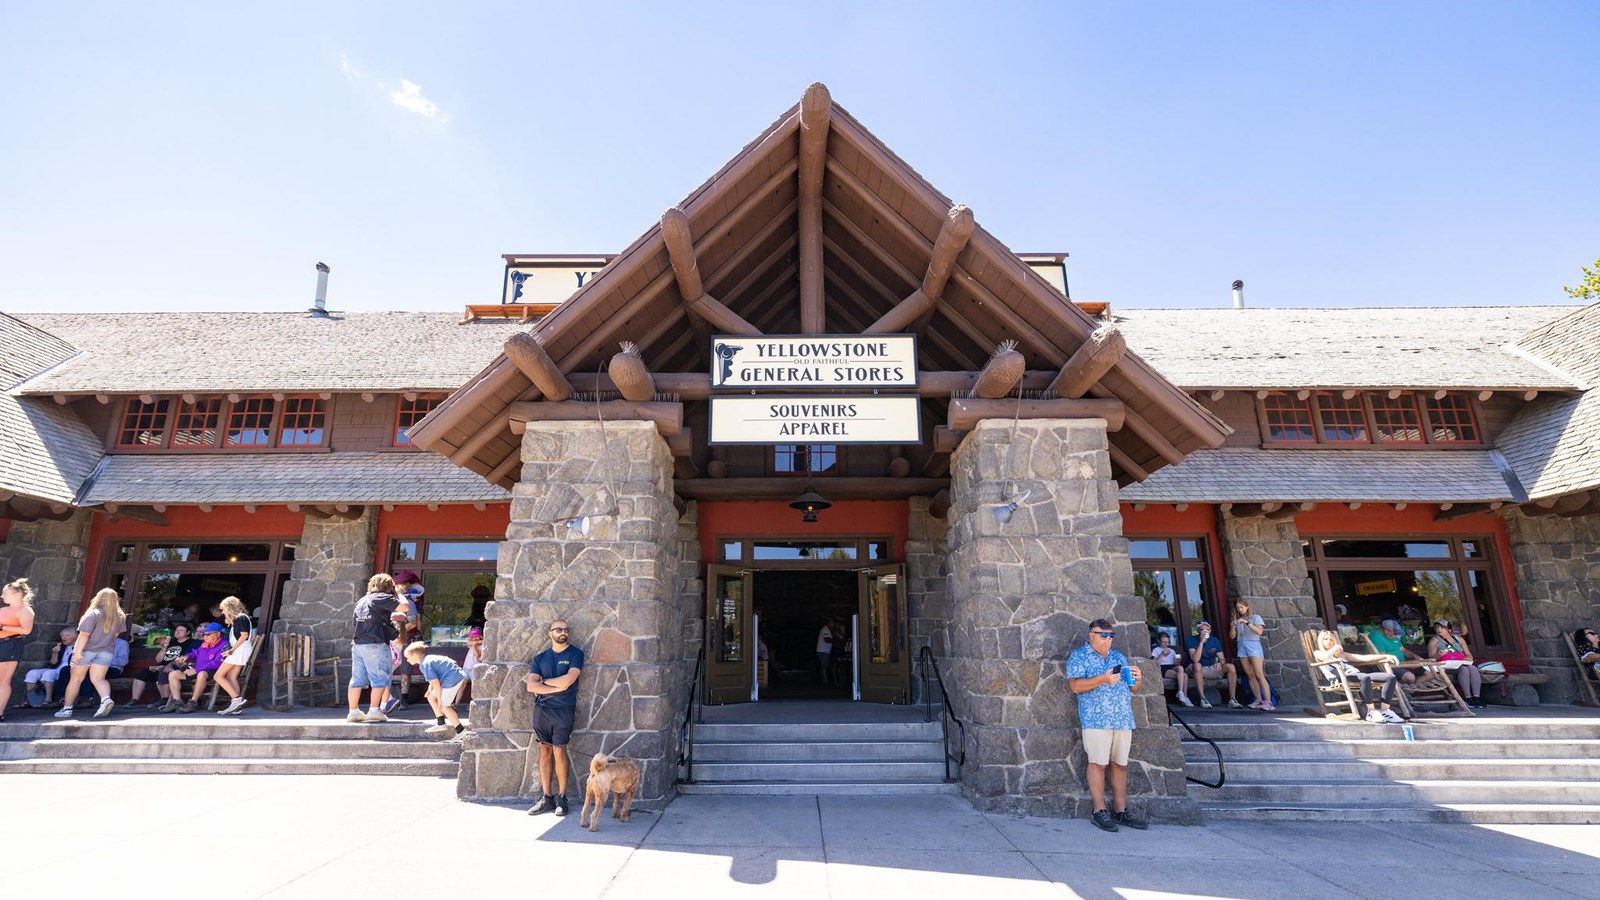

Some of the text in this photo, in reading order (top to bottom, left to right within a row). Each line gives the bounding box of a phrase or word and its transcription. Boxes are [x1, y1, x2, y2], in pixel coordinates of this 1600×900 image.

[756, 343, 888, 357] YELLOWSTONE
[740, 367, 904, 382] GENERAL STORES
[769, 404, 857, 418] SOUVENIRS
[779, 422, 849, 436] APPAREL
